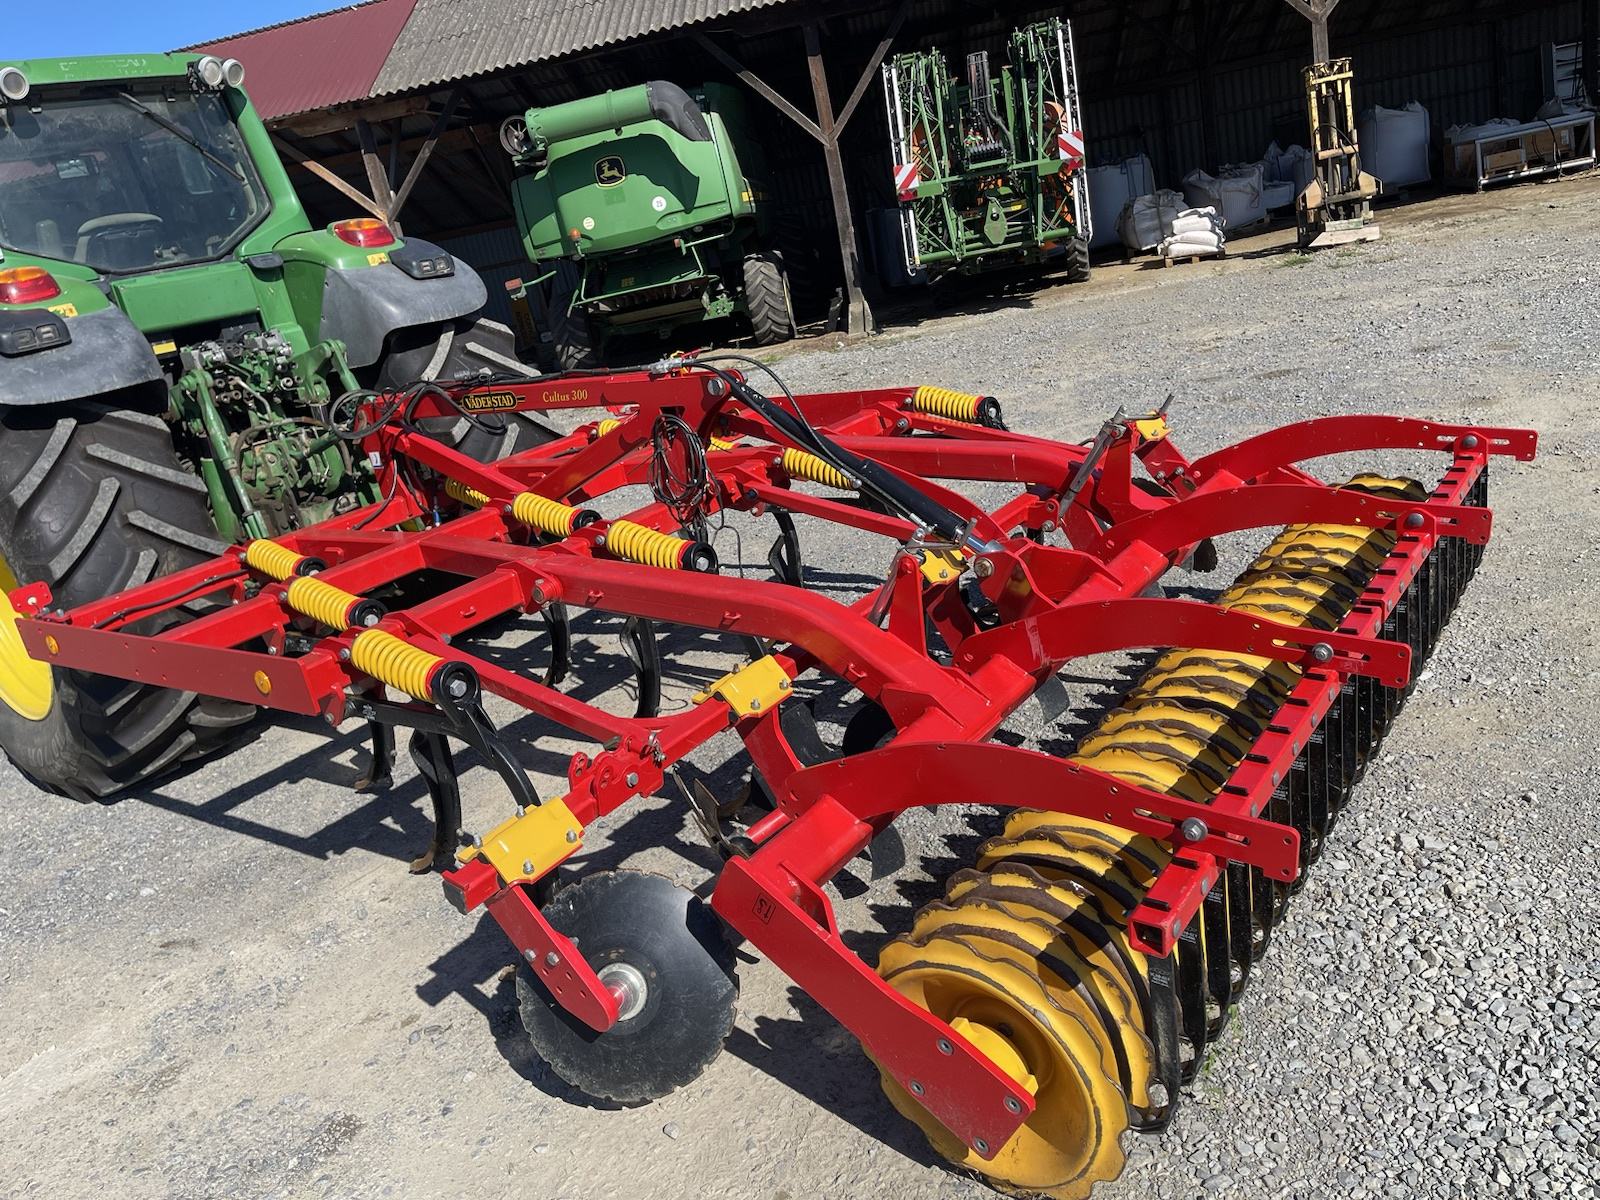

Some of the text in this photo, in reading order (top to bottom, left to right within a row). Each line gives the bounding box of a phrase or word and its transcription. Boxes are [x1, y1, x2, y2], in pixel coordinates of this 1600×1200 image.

[465, 393, 514, 409] VÄDERSTAD
[542, 390, 588, 403] Cultus 300
